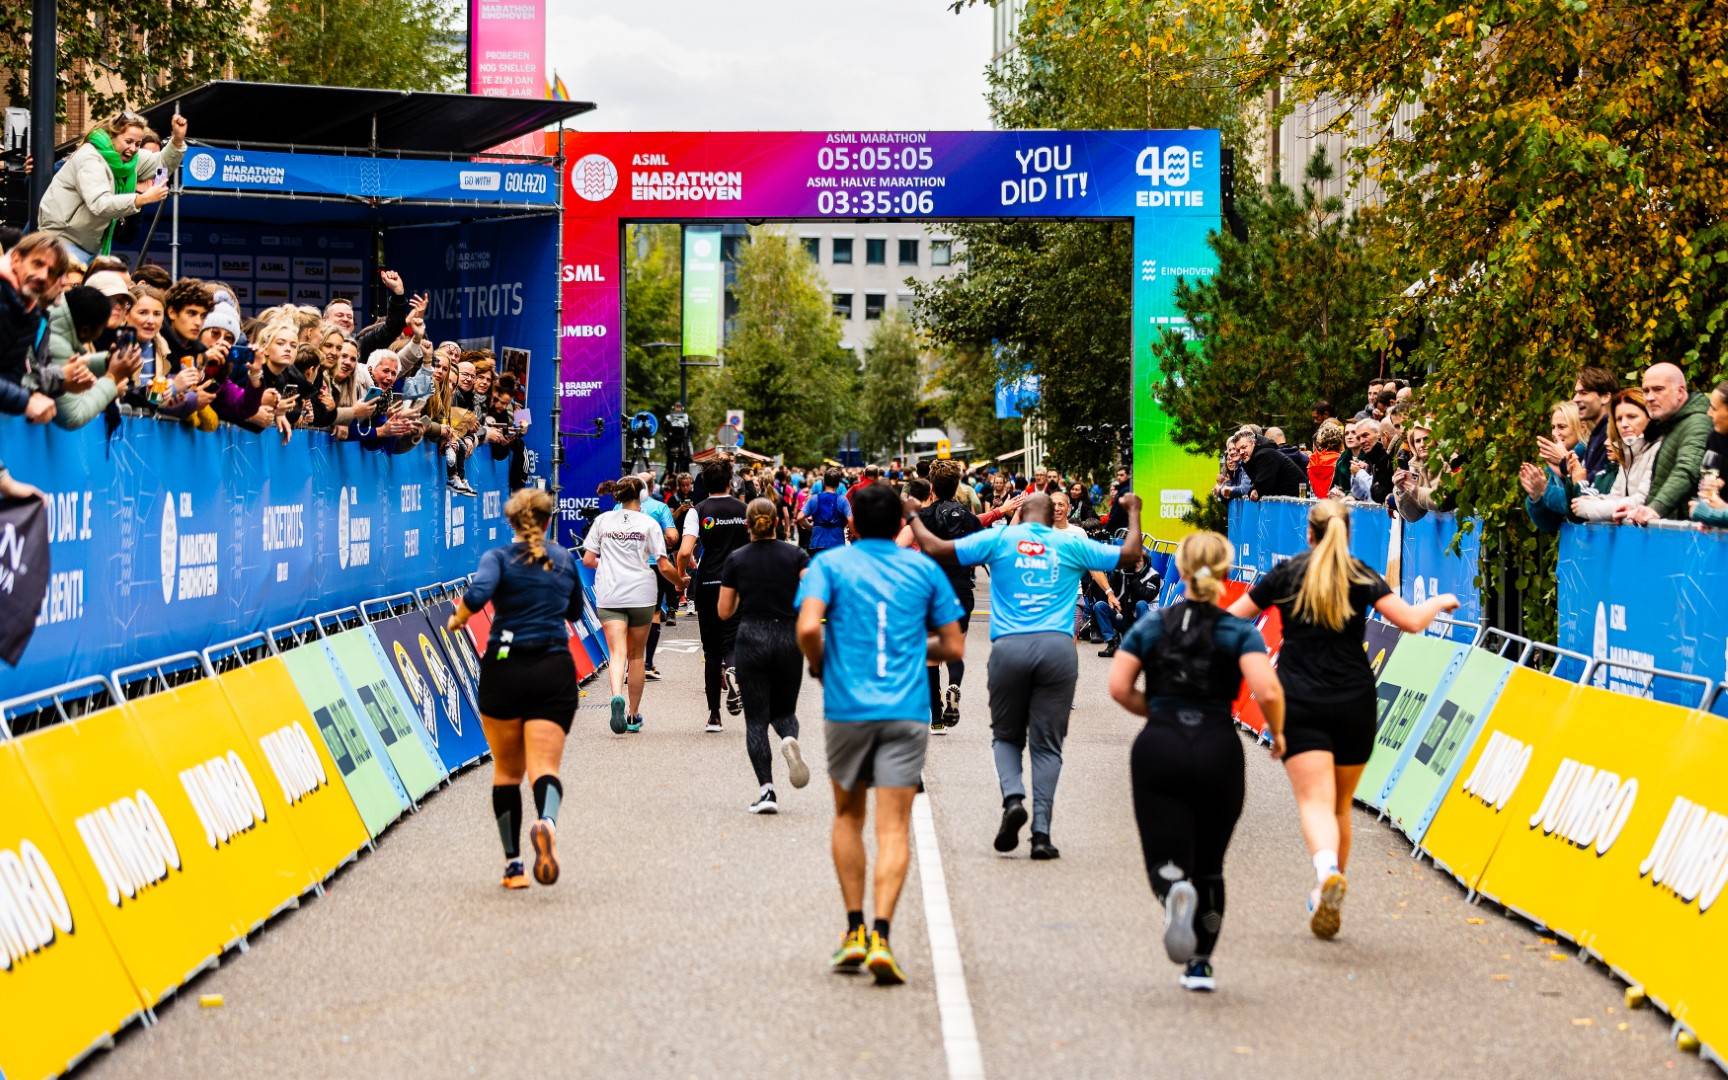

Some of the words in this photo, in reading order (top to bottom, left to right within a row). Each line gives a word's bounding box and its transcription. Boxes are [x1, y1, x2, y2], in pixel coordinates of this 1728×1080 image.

[485, 50, 530, 60] PROBEREN
[480, 63, 497, 73] NOG
[498, 63, 537, 73] SNELLER
[482, 75, 493, 85] TE
[514, 75, 534, 85] DAN
[482, 87, 508, 97] VORIG
[510, 87, 533, 97] JAAR
[826, 133, 857, 144] ASML
[860, 133, 926, 144] MARATHON
[224, 155, 246, 163] ASML
[632, 154, 669, 166] ASML
[817, 146, 934, 171] 05:05:05
[1015, 144, 1072, 174] YOU
[223, 164, 285, 177] MARATHON
[222, 173, 284, 185] EINDHOVEN
[464, 176, 474, 185] GO
[504, 172, 547, 194] GOLAZO
[631, 171, 742, 187] MARATHON
[806, 176, 838, 187] ASML
[841, 176, 877, 187] HALVE
[879, 176, 946, 188] MARATHON
[631, 186, 742, 200] EINDHOVEN
[1001, 176, 1047, 206] DID
[1055, 171, 1088, 200] IT!
[817, 190, 934, 215] 03:35:06
[1136, 191, 1204, 207] EDITIE
[562, 264, 605, 282] SML
[1161, 266, 1214, 276] EINDHOVEN
[565, 381, 603, 389] BRABANT
[565, 389, 592, 397] SPORT
[559, 497, 600, 509] #ONZE
[57, 492, 78, 540] DAT
[1014, 557, 1048, 570] ASML
[258, 720, 327, 807] JUMBO
[178, 749, 267, 850] JUMBO
[1529, 757, 1639, 858] JUMBO
[75, 788, 182, 907] JUMBO
